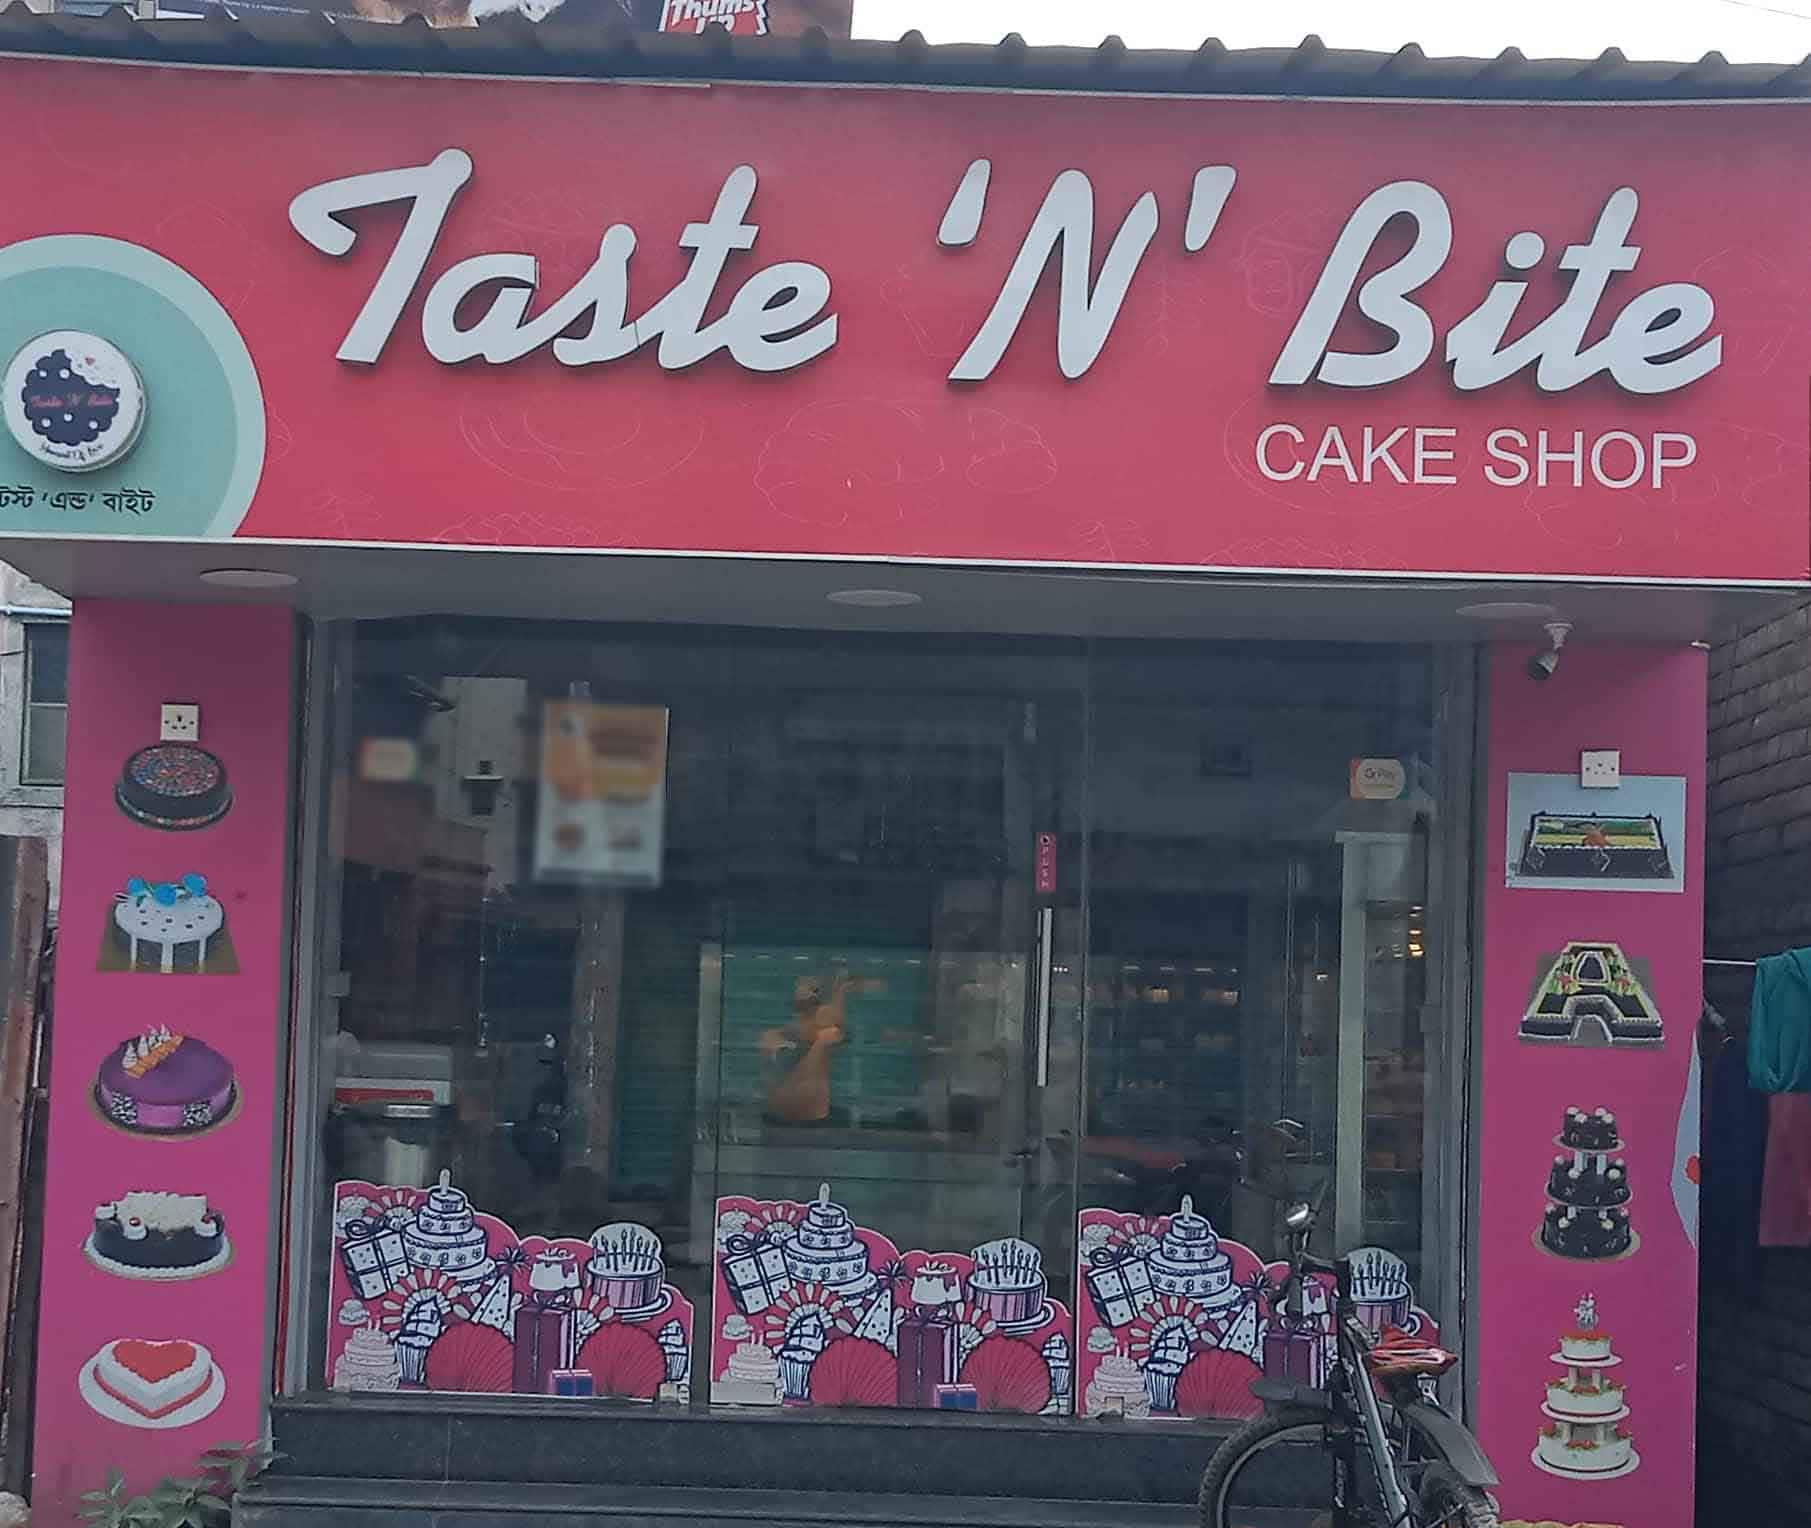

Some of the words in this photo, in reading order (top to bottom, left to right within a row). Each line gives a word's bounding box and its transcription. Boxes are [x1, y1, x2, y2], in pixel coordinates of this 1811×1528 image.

[288, 149, 838, 371] Taste
[938, 158, 1237, 381] 'N'
[1268, 180, 1723, 395] Bite
[1256, 423, 1457, 486] CAKE
[1484, 428, 1697, 489] SHOP
[102, 487, 156, 516] বাইট
